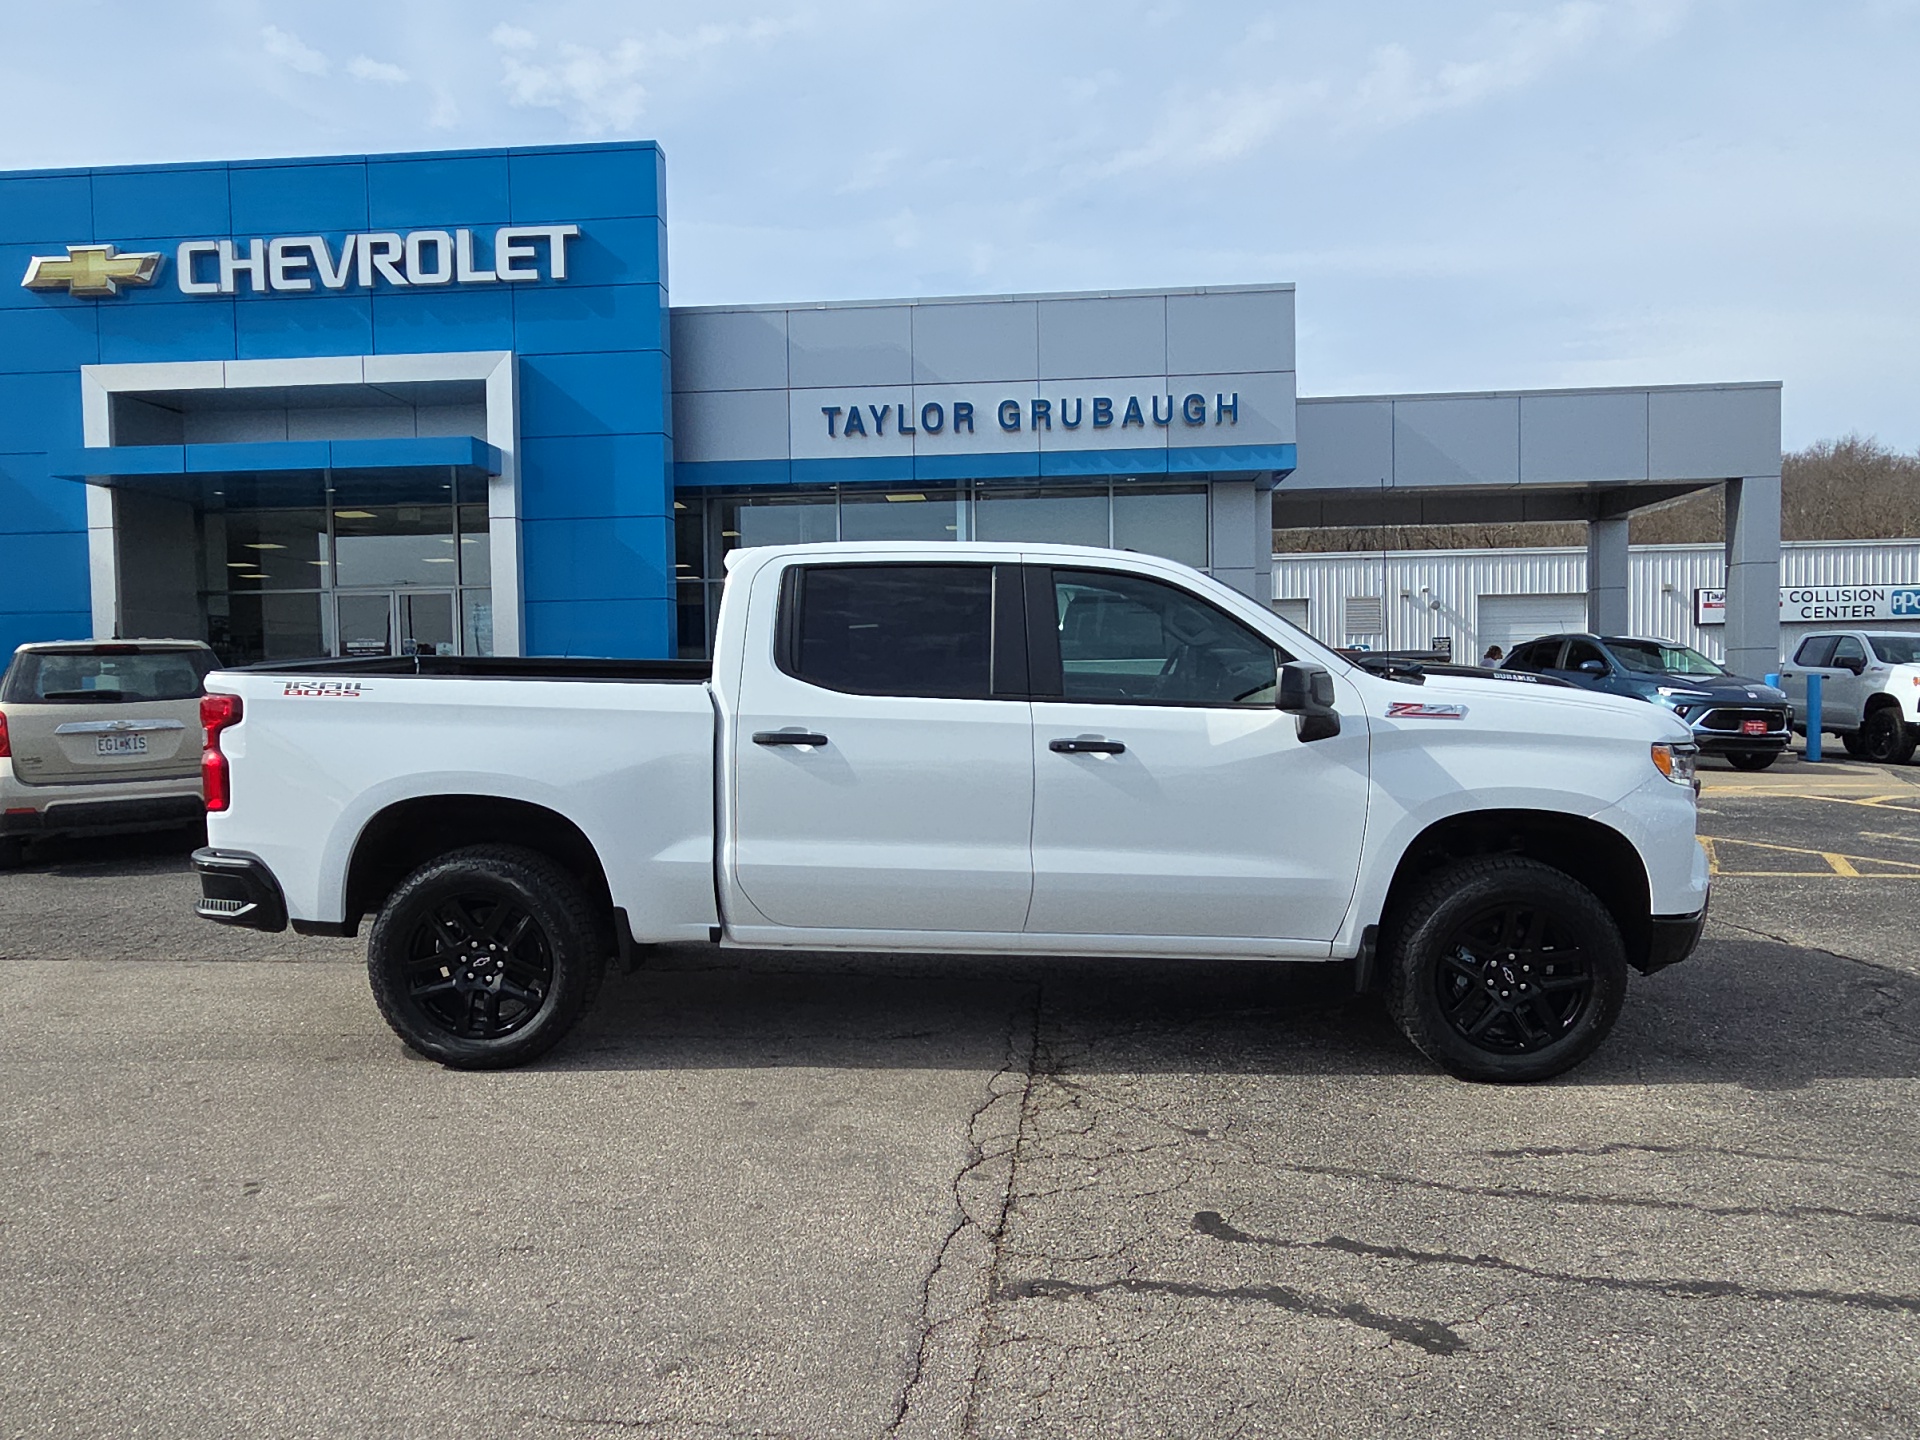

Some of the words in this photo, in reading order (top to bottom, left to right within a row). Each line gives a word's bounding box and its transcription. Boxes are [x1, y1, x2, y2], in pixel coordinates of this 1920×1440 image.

[176, 224, 579, 295] CHEVROLET
[821, 401, 975, 438] TAYLOR
[996, 392, 1240, 430] GRUBAUGH
[1789, 589, 1885, 604] COLLISION
[1800, 605, 1876, 619] CENTER
[273, 680, 374, 691] TRAIL
[283, 688, 361, 697] BOSS
[1384, 702, 1470, 721] Z71
